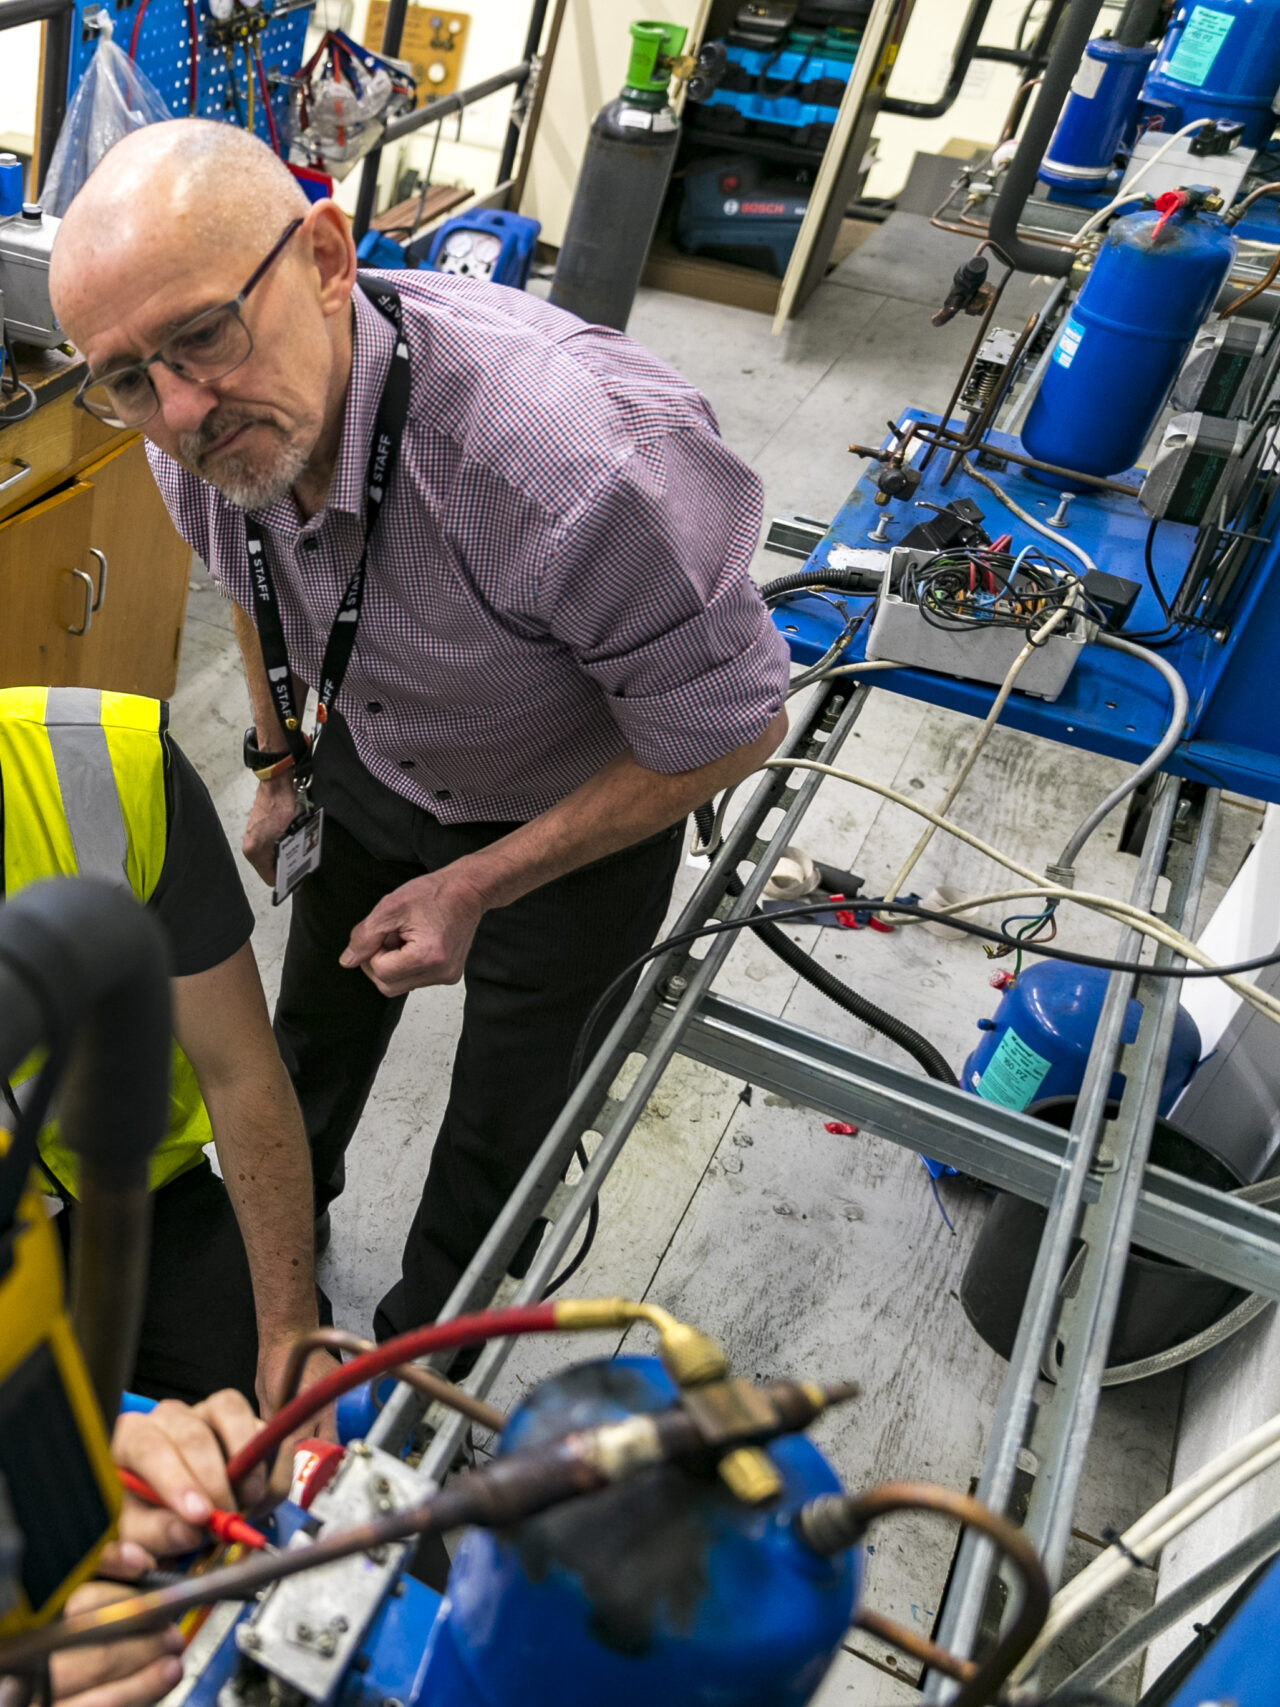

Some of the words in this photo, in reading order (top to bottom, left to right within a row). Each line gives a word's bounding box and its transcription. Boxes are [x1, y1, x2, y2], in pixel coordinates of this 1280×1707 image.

[741, 202, 785, 215] BOSCH
[373, 433, 391, 482] STAFF
[253, 558, 270, 601] STAFF
[276, 684, 293, 718] STAF
